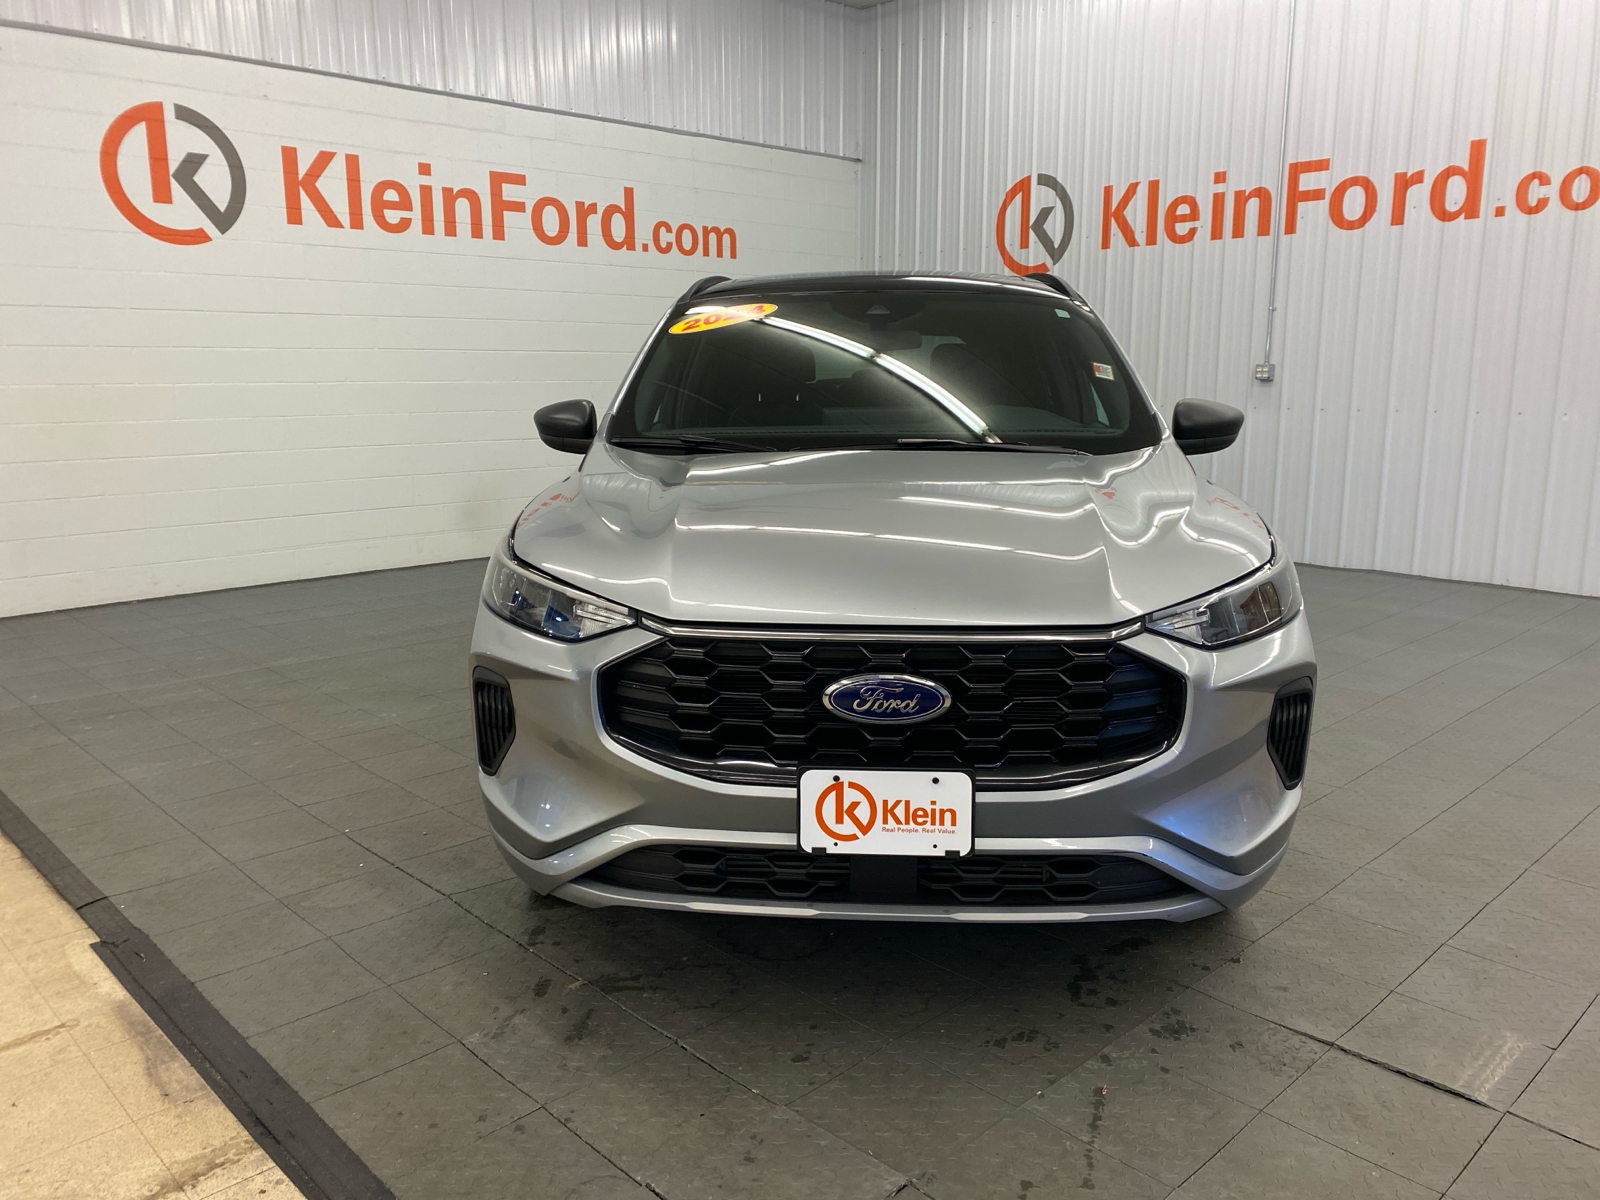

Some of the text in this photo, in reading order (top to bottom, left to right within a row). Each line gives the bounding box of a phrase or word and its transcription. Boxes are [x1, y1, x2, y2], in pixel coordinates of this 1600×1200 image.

[281, 145, 737, 259] KleinFord.com
[853, 685, 921, 713] Ford
[882, 799, 957, 827] Klein
